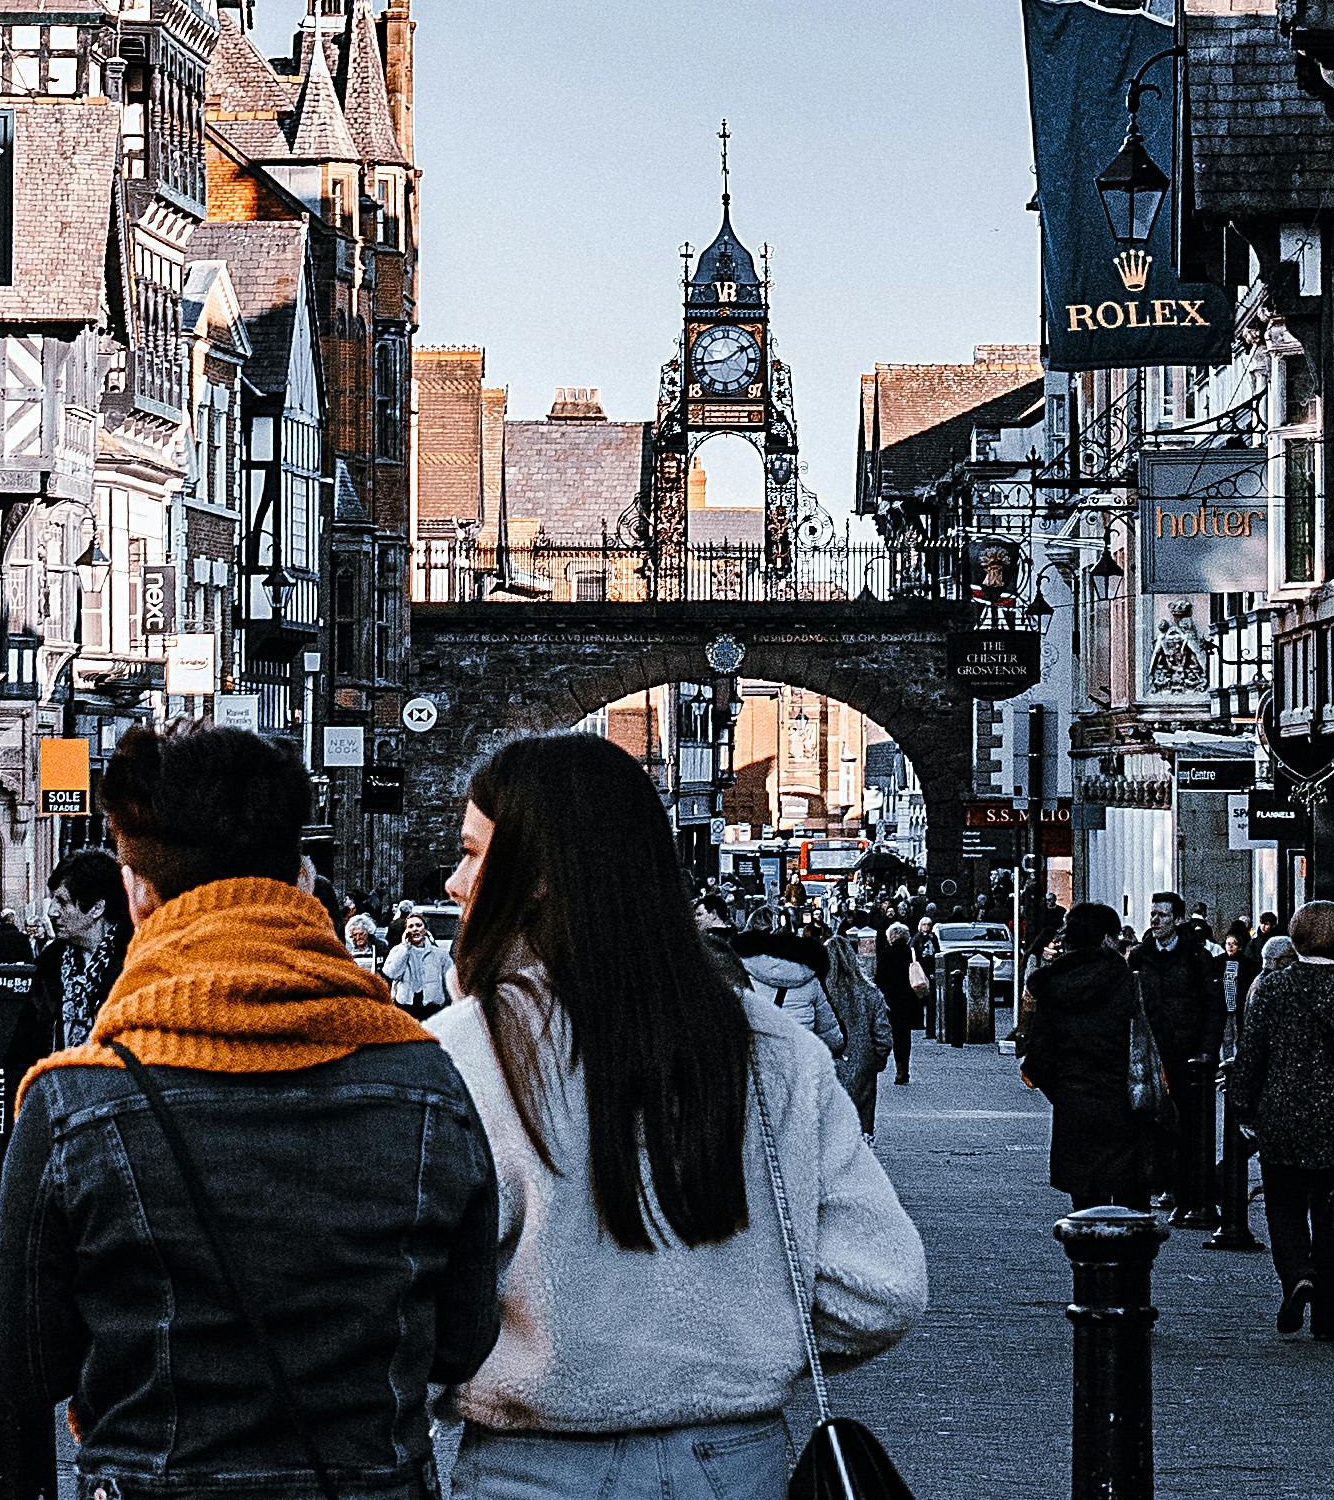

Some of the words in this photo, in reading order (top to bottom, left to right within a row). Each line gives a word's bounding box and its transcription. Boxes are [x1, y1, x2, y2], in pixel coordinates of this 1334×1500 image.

[1066, 300, 1211, 331] ROLEX
[688, 383, 702, 397] 18
[748, 383, 763, 398] 97
[1156, 505, 1265, 538] hotter
[145, 572, 164, 629] next
[982, 641, 1005, 651] THE
[967, 653, 1018, 663] CHESTER
[957, 665, 1028, 676] GROSVENOR
[330, 739, 356, 747] NEW
[48, 792, 80, 803] SOLE
[49, 804, 79, 812] TRADER
[1018, 808, 1070, 822] MLTO
[1257, 811, 1295, 819] FLANNELS
